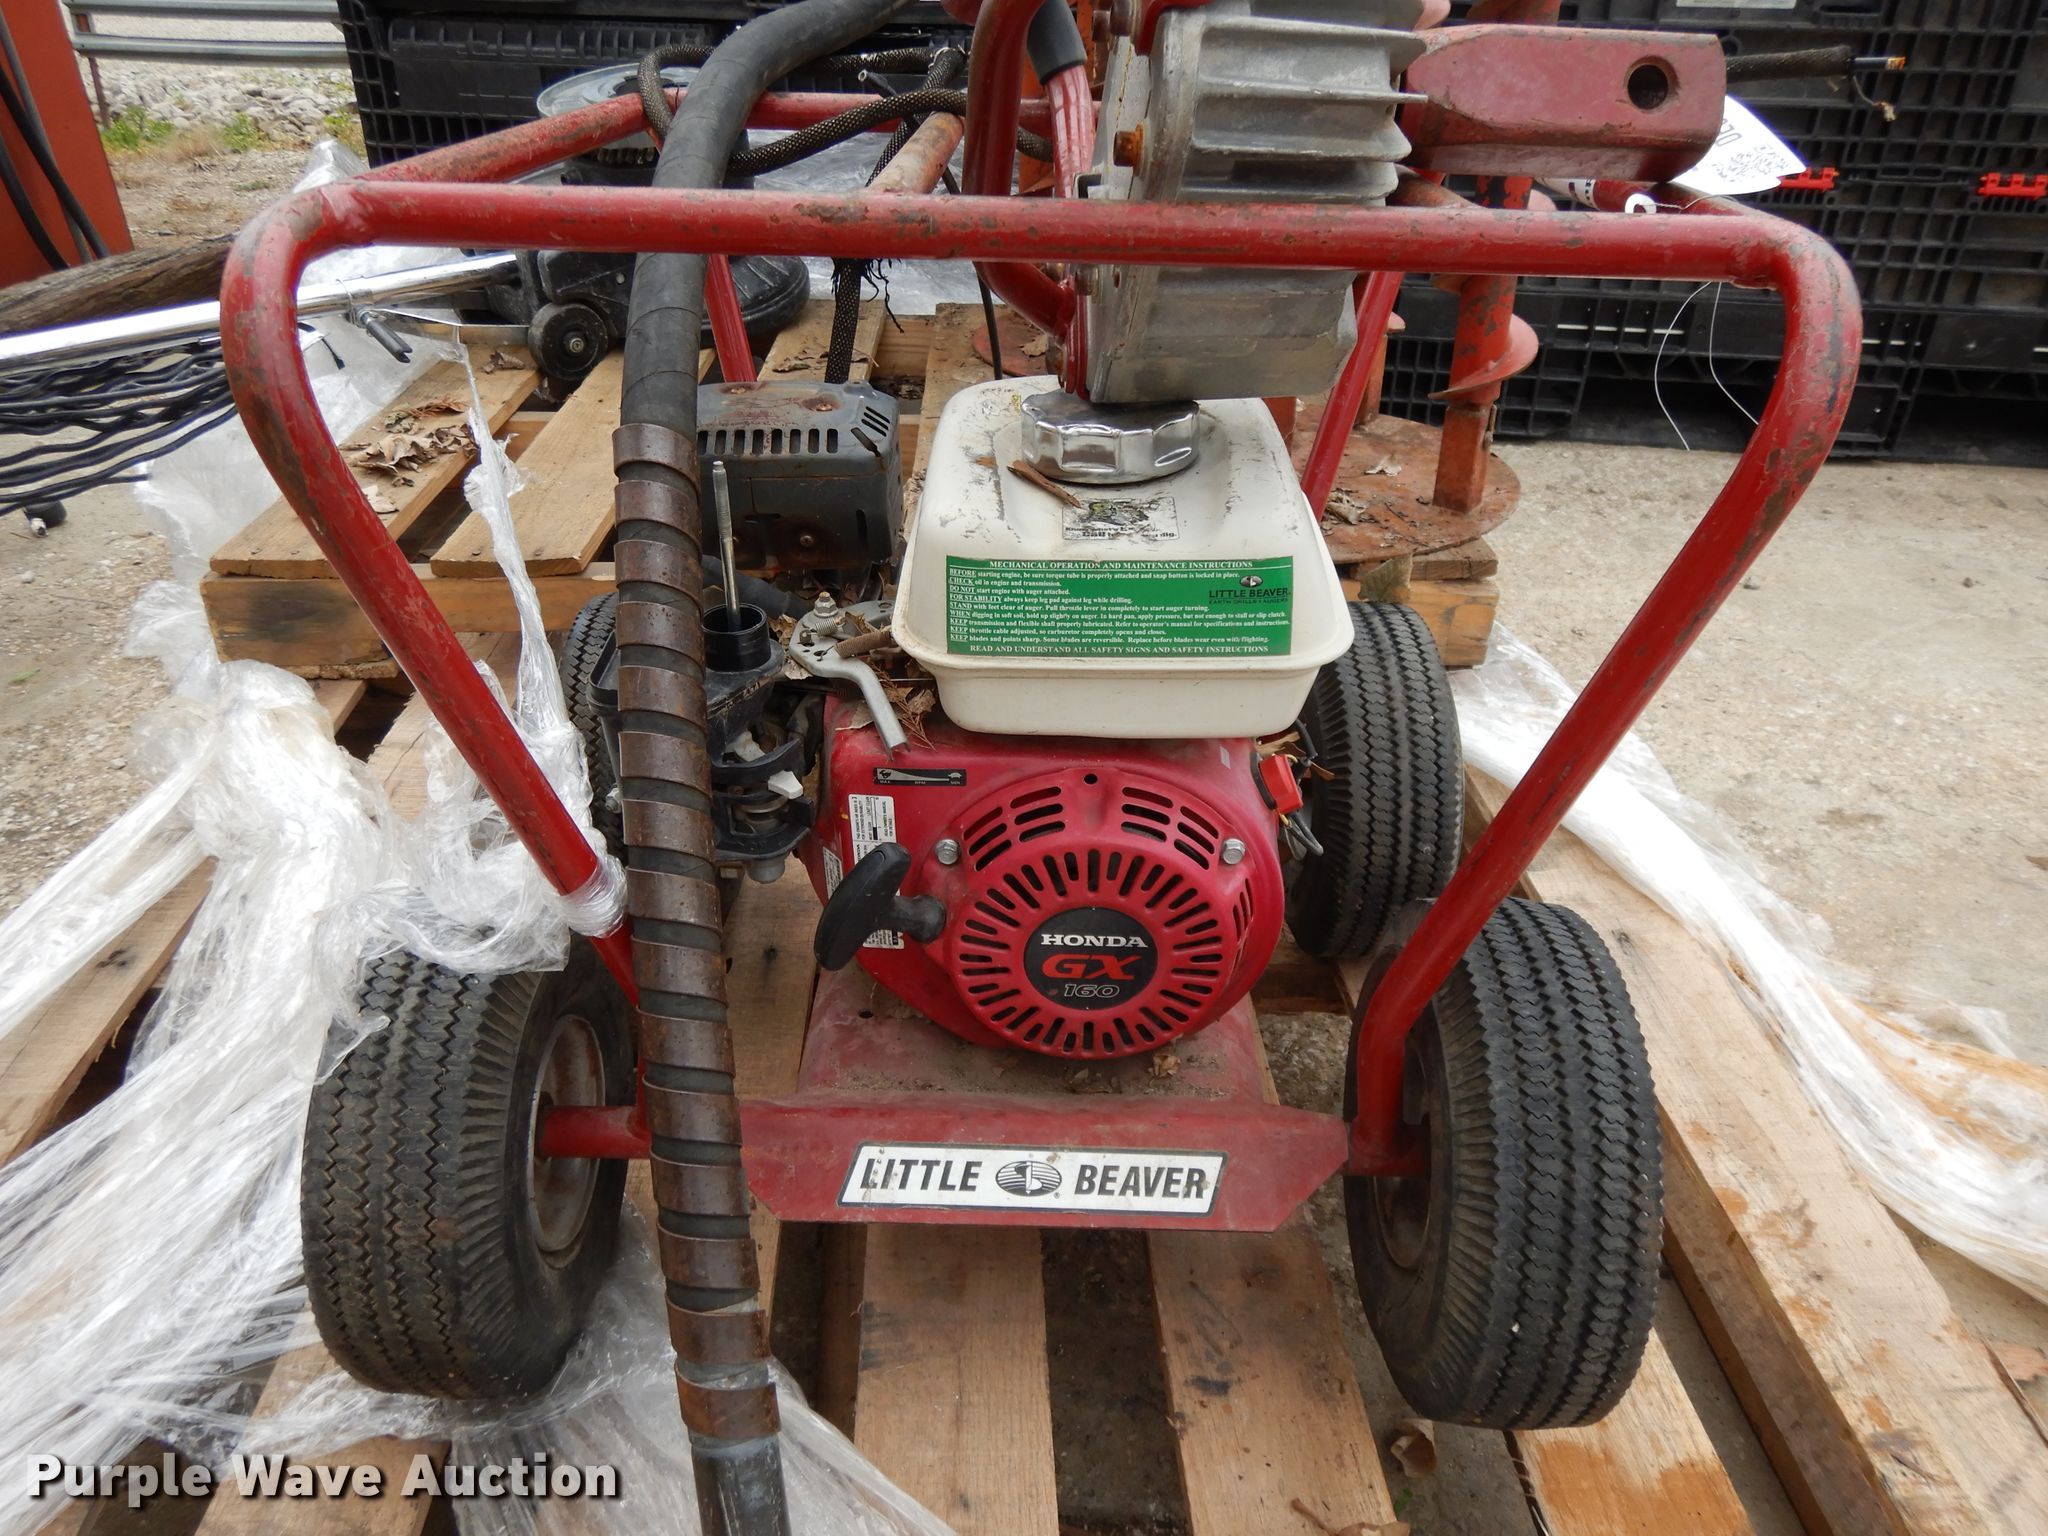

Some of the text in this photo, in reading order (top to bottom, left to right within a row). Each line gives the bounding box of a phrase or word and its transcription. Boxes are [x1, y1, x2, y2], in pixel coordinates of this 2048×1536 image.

[989, 561, 1252, 569] MECHANICAL OPERATION AND MAINTENANCE INSTRUCTIONS
[977, 571, 1000, 579] starting
[1045, 572, 1065, 580] torque
[1086, 572, 1112, 580] properly
[1222, 571, 1239, 579] place.
[990, 579, 1009, 587] engine
[991, 587, 1010, 595] engine
[1209, 587, 1288, 598] LITTLE BEAVER
[1003, 596, 1023, 604] always
[1024, 596, 1038, 604] keep
[1038, 596, 1048, 604] leg
[1048, 596, 1060, 604] pad
[1060, 596, 1082, 604] against
[1082, 596, 1091, 604] leg
[1109, 596, 1132, 604] drilling.
[1107, 604, 1140, 612] completely
[971, 611, 993, 619] digging
[1049, 612, 1070, 620] slightly
[1137, 613, 1153, 621] apply
[1204, 612, 1226, 620] enough
[1256, 611, 1267, 619] slip
[1056, 620, 1081, 628] properly
[1203, 620, 1242, 628] specifications
[1081, 628, 1114, 636] completely
[1002, 635, 1021, 643] points
[1022, 635, 1041, 643] sharp.
[1127, 636, 1152, 644] Replace
[1241, 636, 1268, 644] flighting.
[970, 644, 1268, 653] READ AND UNDERSTAND ALL SAFETY SIGNS AND SAFETY INSTRUCTIONS
[1041, 934, 1148, 948] HONDA
[1042, 953, 1143, 980] GX
[1064, 984, 1120, 998] 160
[860, 1158, 1207, 1199] LITTLE BEAVER
